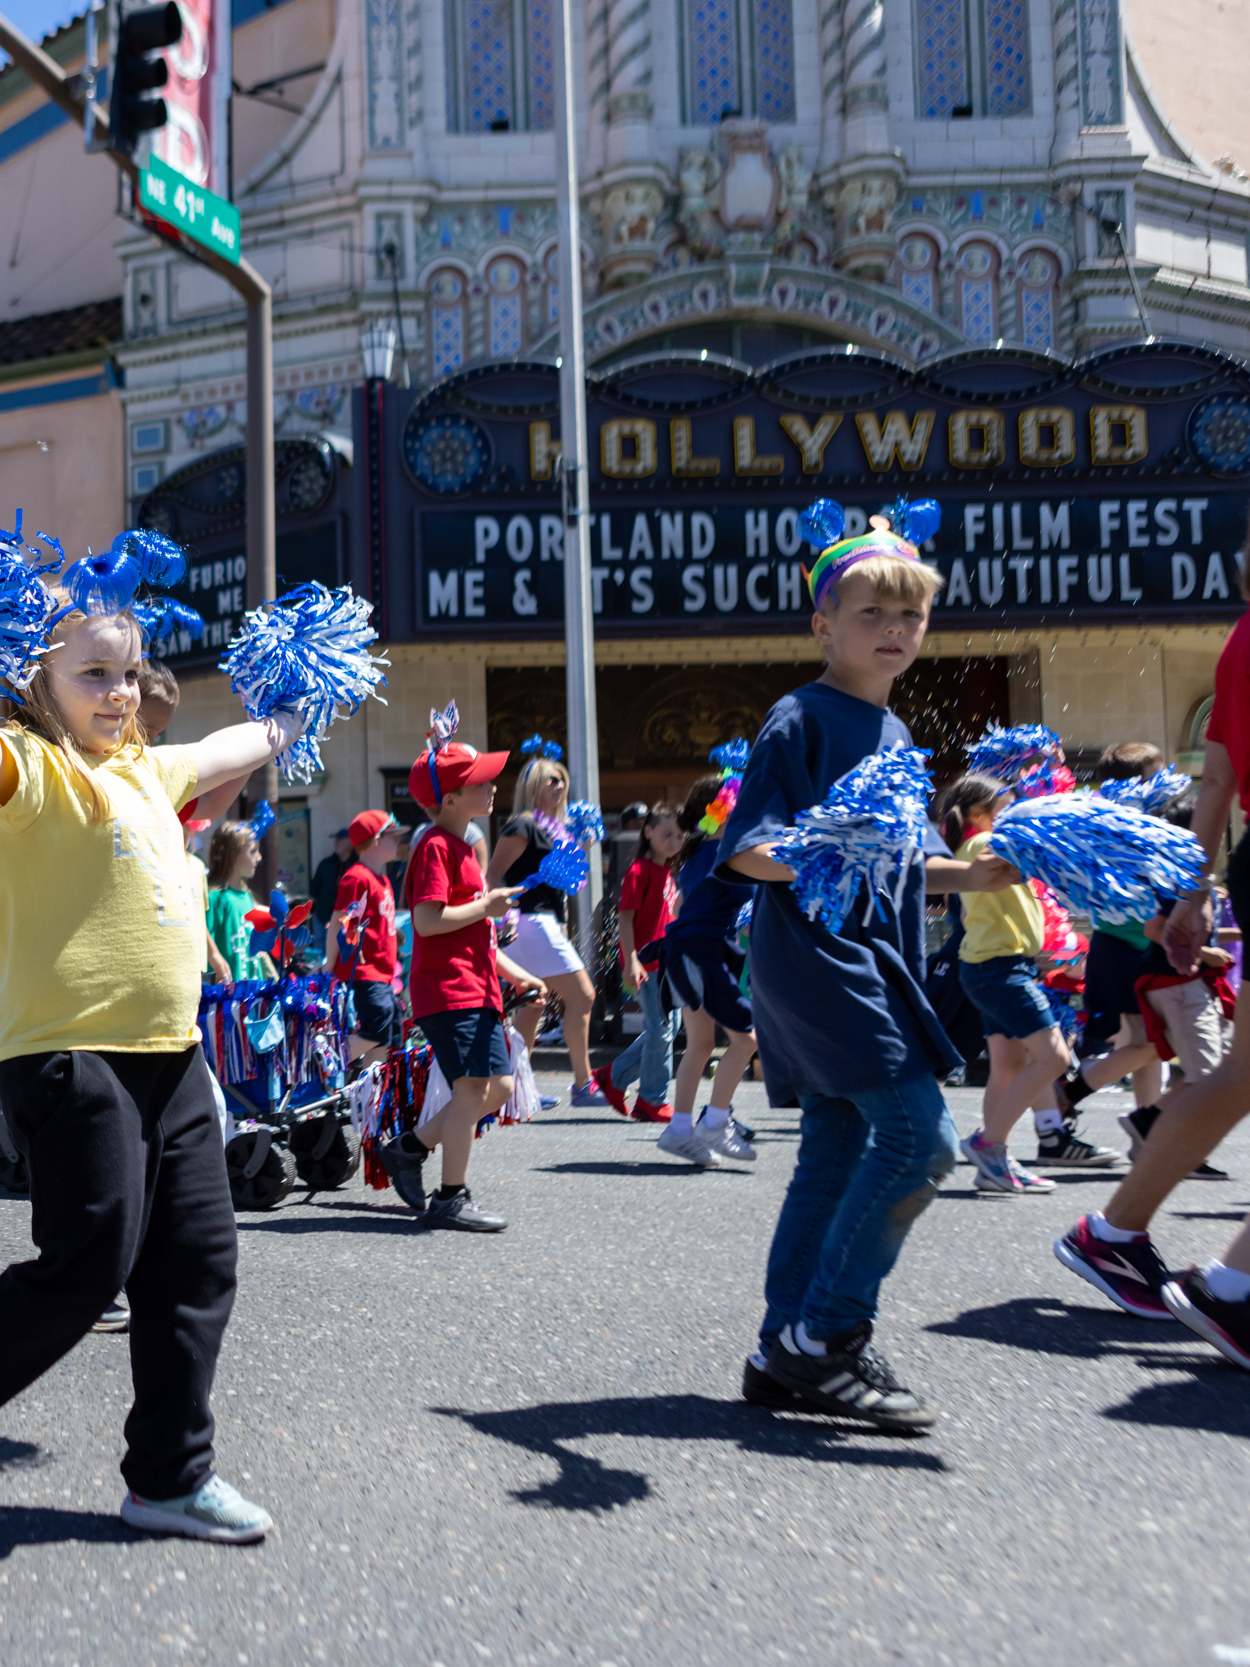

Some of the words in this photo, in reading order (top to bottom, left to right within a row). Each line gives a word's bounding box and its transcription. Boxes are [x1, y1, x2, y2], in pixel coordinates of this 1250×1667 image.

[147, 173, 166, 206] NE
[474, 510, 716, 563] PORLAND
[745, 506, 937, 558] HOR
[964, 502, 1071, 552] FILM
[1099, 497, 1209, 548] FEST
[190, 556, 246, 592] FURIO
[428, 568, 486, 618] ME
[512, 568, 538, 616] &
[591, 565, 654, 614] T'S
[682, 562, 802, 613] SUCH
[920, 553, 1143, 606] AUTIFUL
